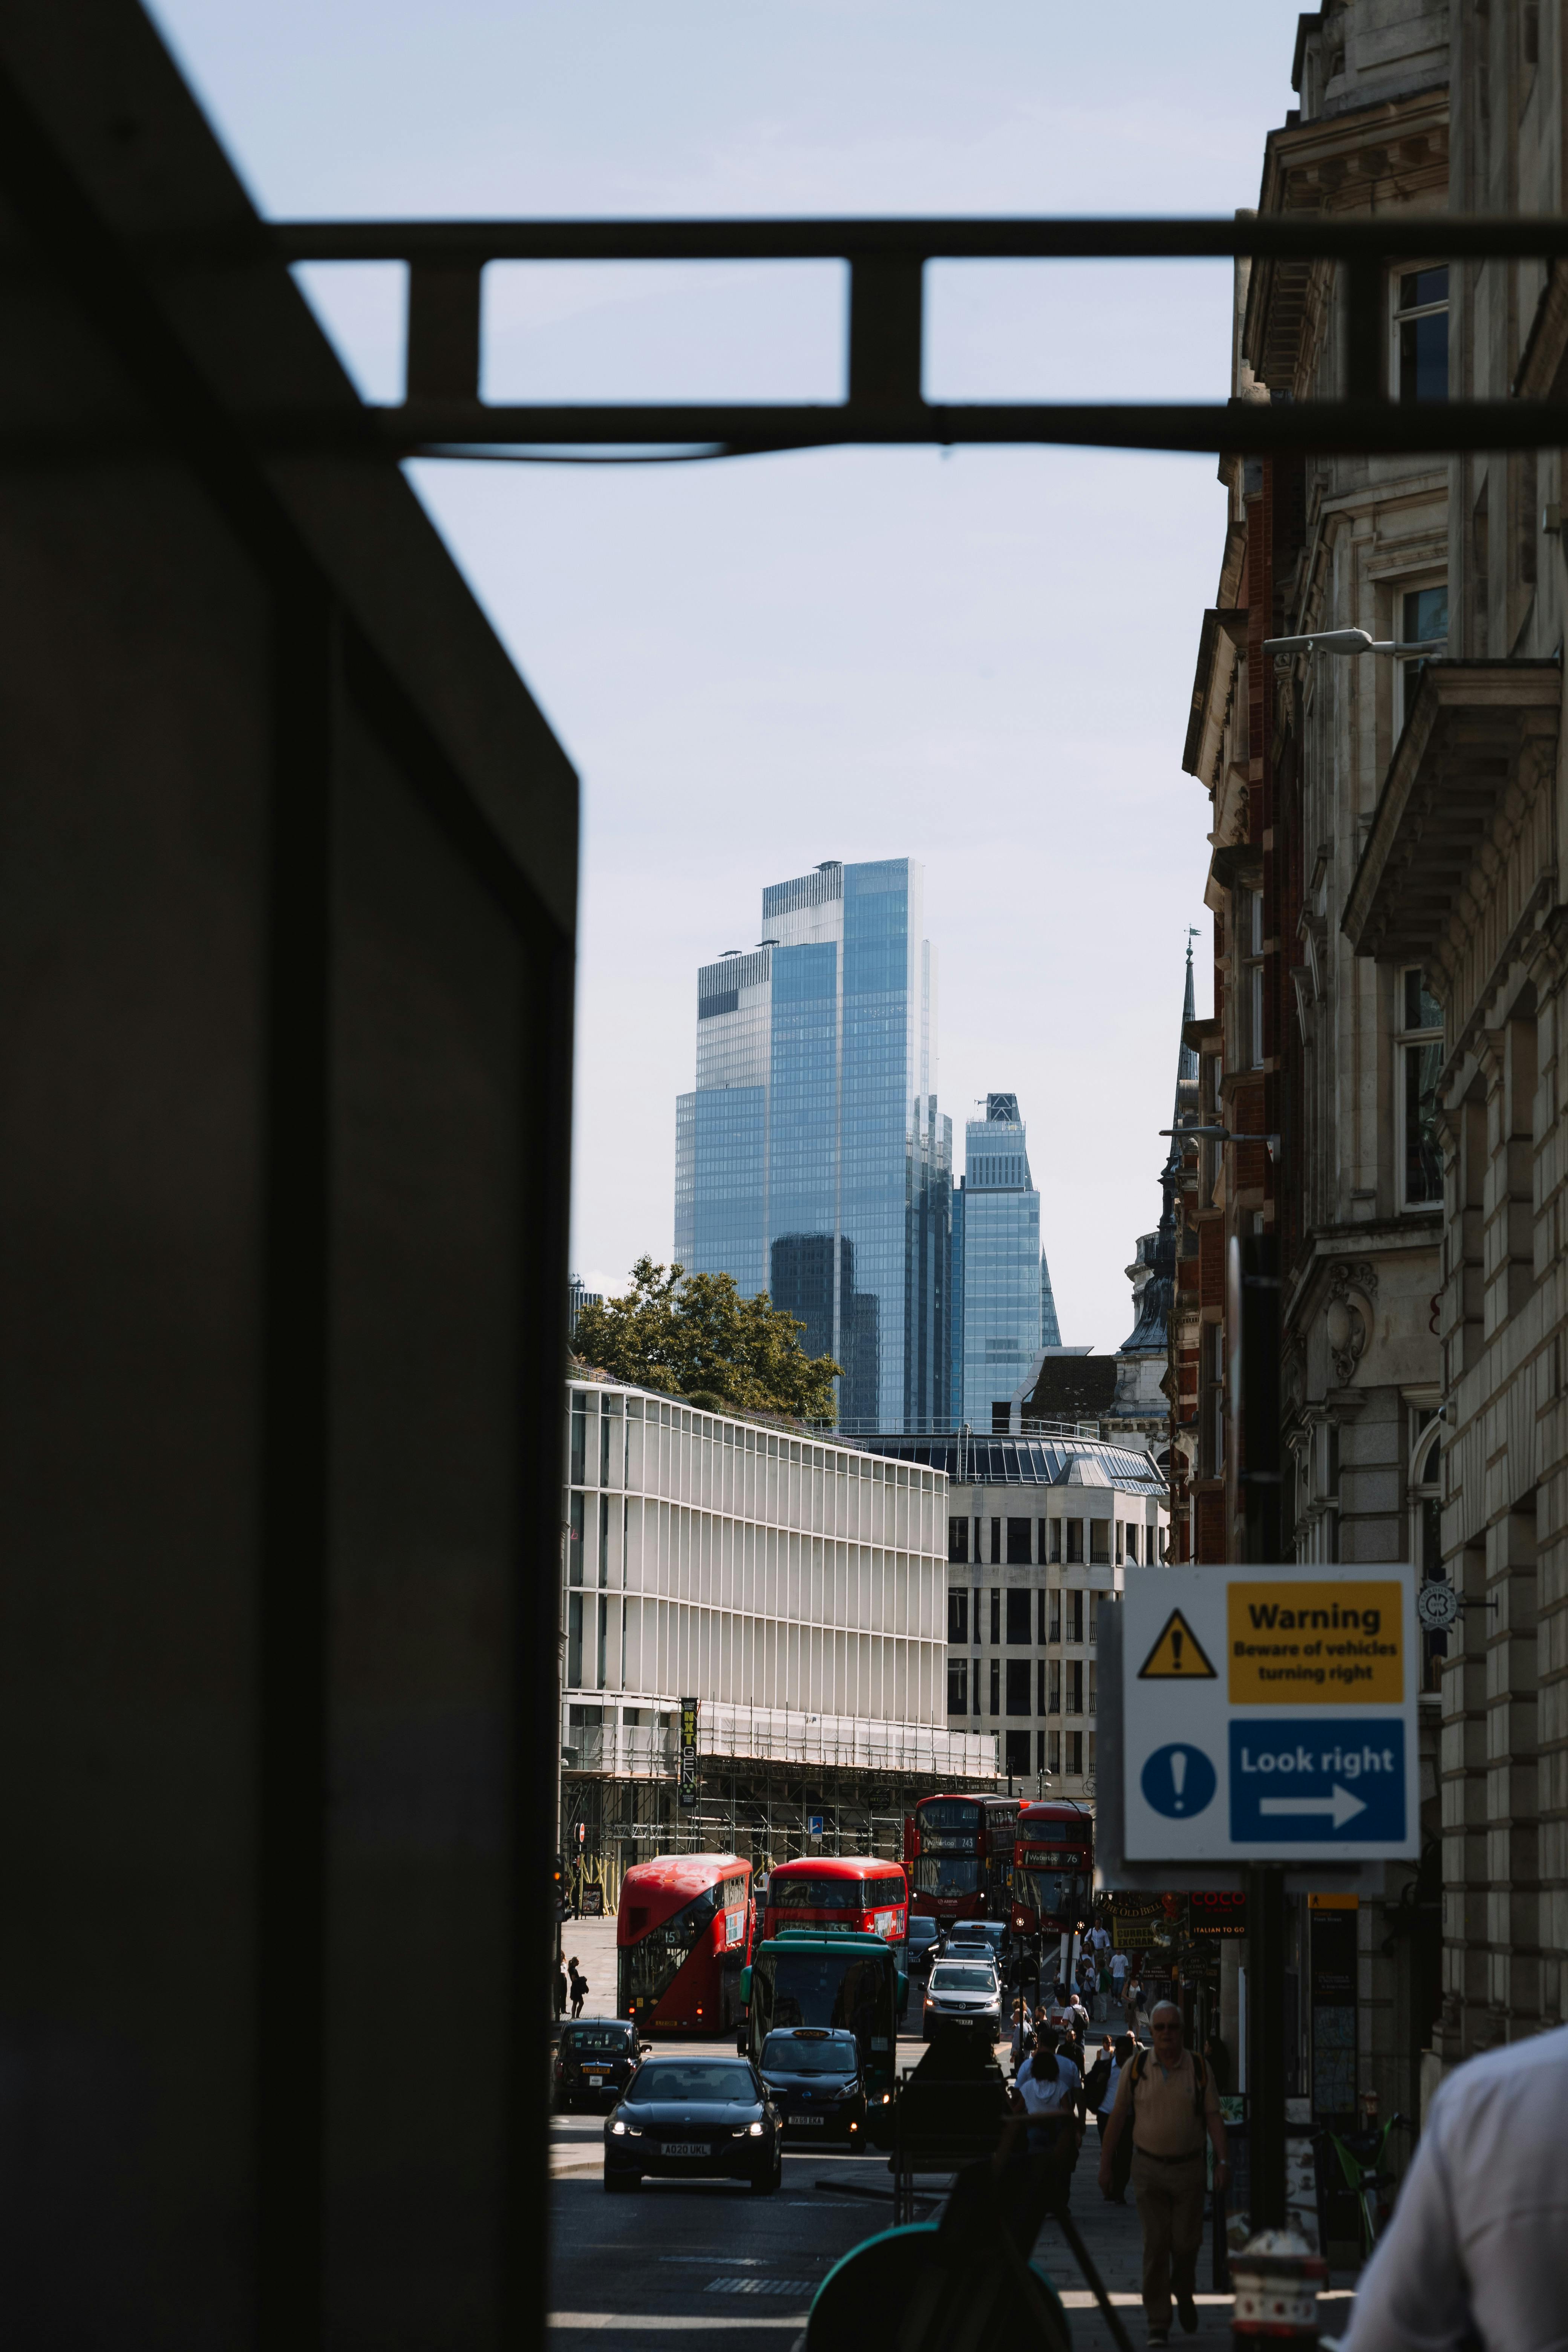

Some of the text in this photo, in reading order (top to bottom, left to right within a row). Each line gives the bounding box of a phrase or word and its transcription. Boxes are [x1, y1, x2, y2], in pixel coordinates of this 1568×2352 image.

[1249, 1603, 1381, 1635] Warning
[1234, 1640, 1397, 1656] Beware of vehicles
[1259, 1664, 1373, 1684] turning right
[1241, 1746, 1393, 1779] Look right
[962, 1839, 972, 1847] 243
[1067, 1854, 1077, 1863] 76
[1192, 1891, 1246, 1905] COCO
[1104, 1900, 1162, 1916] THE OLD BELL
[666, 1931, 675, 1943] 15
[690, 2145, 707, 2154] UKL
